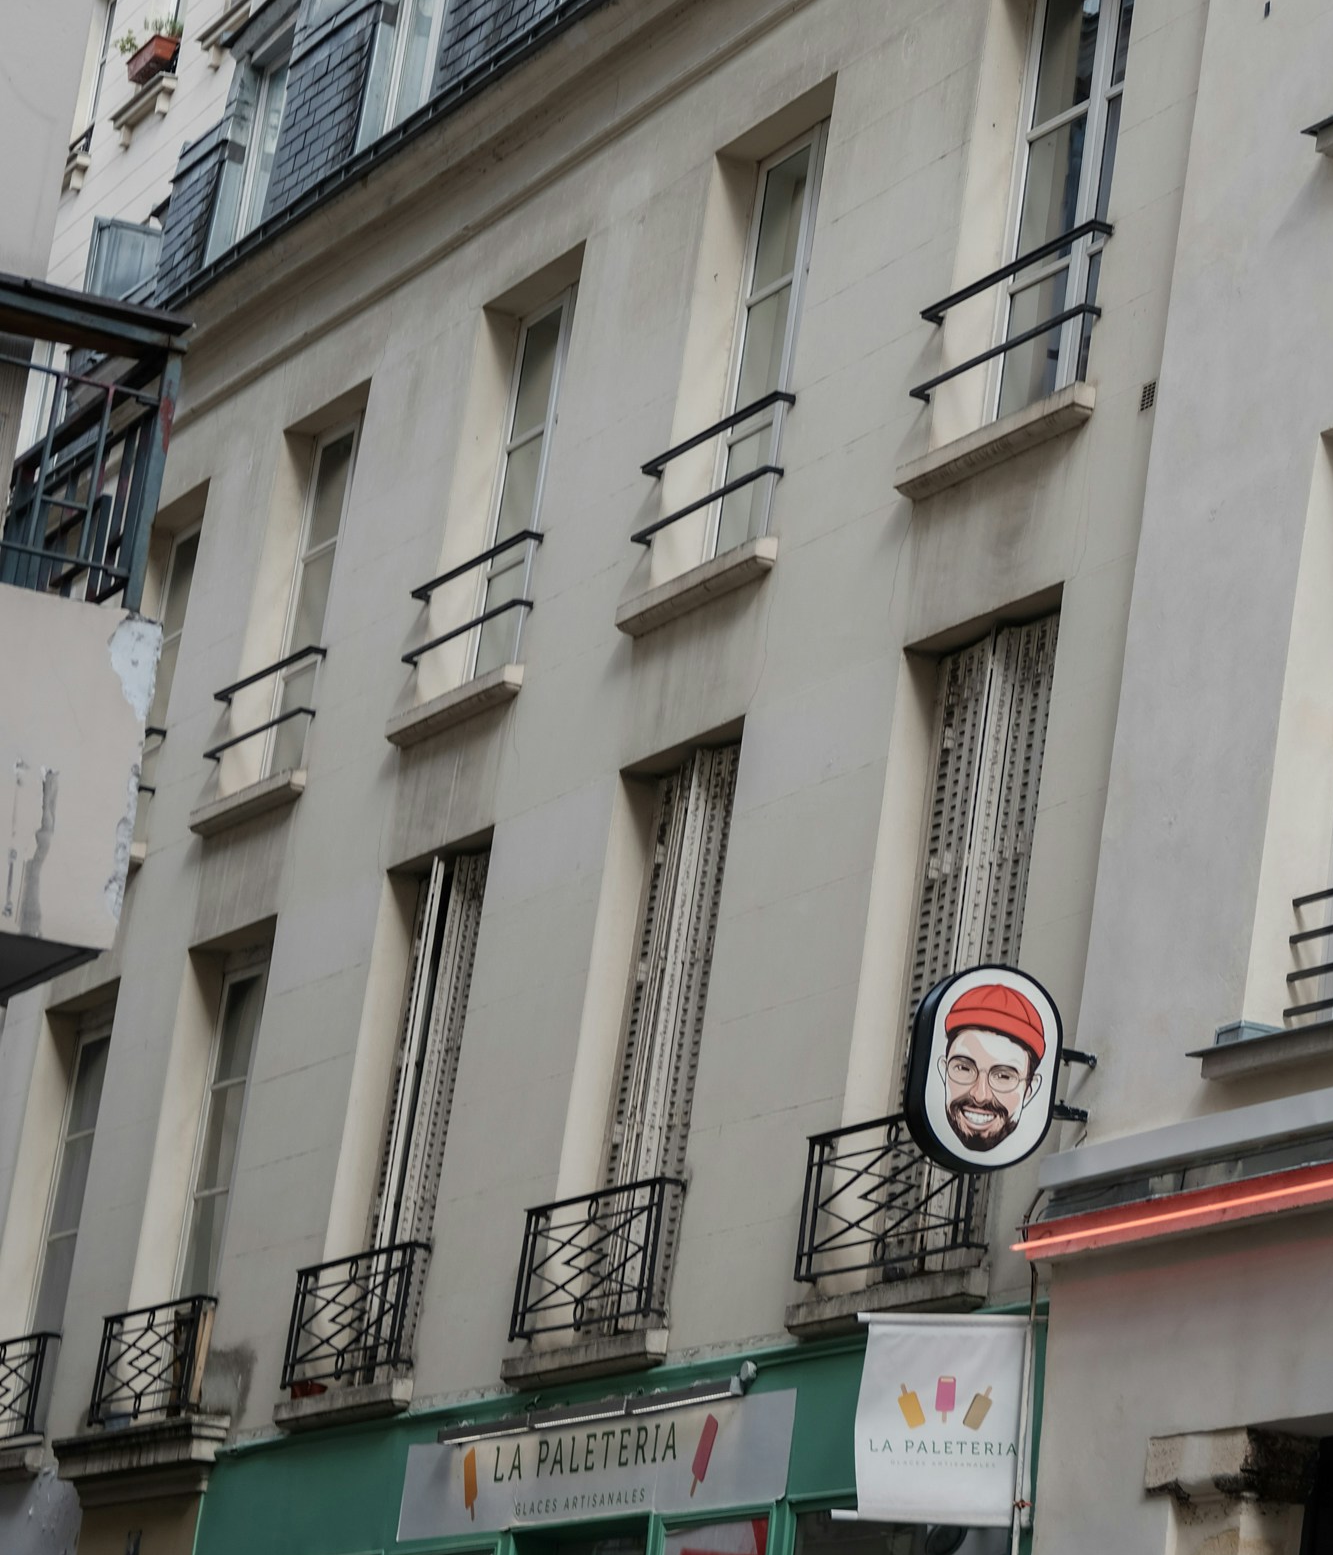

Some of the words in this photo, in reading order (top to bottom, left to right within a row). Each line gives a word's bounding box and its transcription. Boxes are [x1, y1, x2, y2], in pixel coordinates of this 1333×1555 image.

[493, 1443, 522, 1483] LA
[536, 1421, 677, 1478] PALETERIA
[869, 1438, 893, 1453] LA
[905, 1440, 1017, 1456] PALETERIA
[515, 1498, 558, 1516] GLACES
[564, 1488, 646, 1511] ARTISANALES
